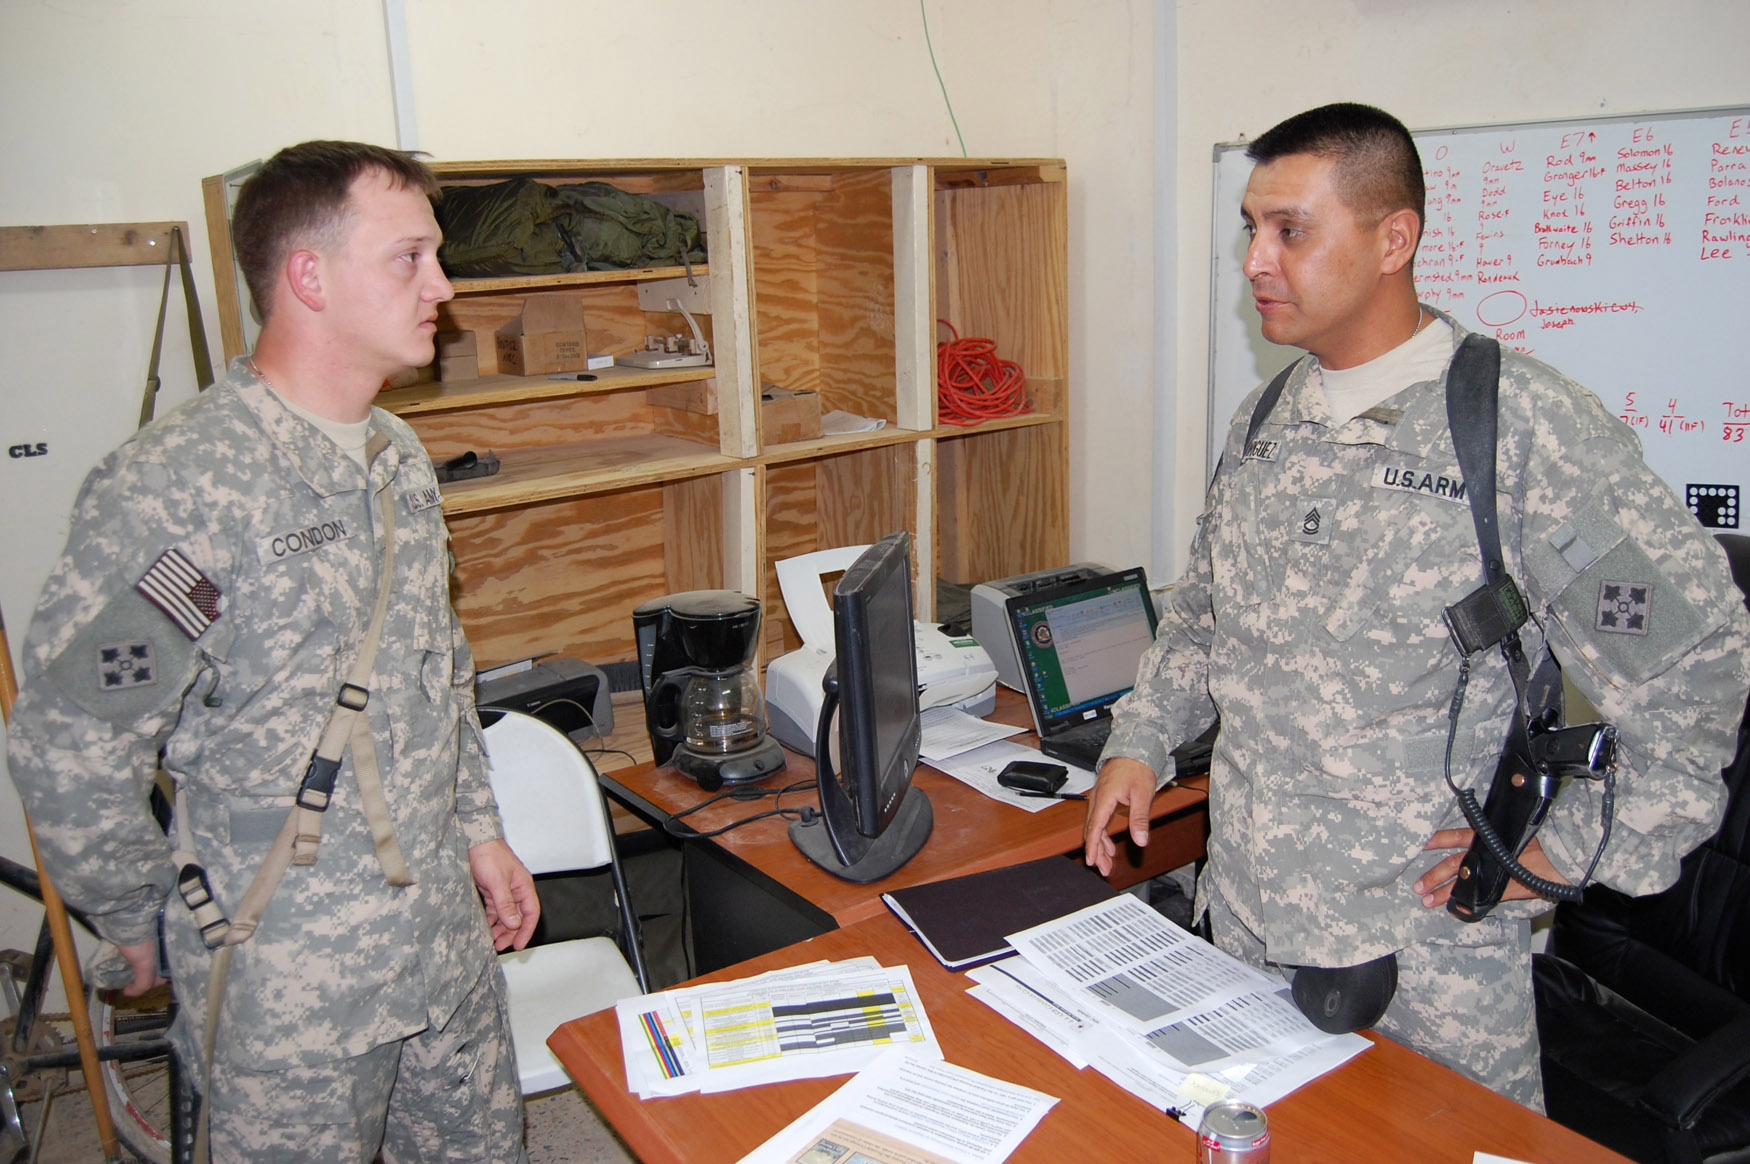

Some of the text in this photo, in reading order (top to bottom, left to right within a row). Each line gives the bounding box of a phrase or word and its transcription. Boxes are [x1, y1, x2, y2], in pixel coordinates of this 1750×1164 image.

[1560, 131, 1586, 149] E7
[1632, 127, 1654, 143] E6
[1499, 139, 1516, 154] W
[1617, 143, 1674, 159] Solomon 16
[1546, 154, 1574, 168] Rod
[1616, 158, 1672, 175] Massey 16
[1616, 171, 1672, 192] Belton 16
[1543, 186, 1585, 206] Eye 16
[1613, 192, 1666, 215] Gregg 16
[1707, 194, 1741, 206] Ford
[1608, 213, 1666, 230] Griffin 16
[1609, 232, 1660, 246] Shelton
[1700, 246, 1733, 260] Lee
[1722, 426, 1745, 443] 83
[8, 442, 49, 459] CLS
[1250, 440, 1278, 459] GUEZ
[1383, 467, 1467, 500] U.S.ARM
[271, 519, 348, 557] CONDON
